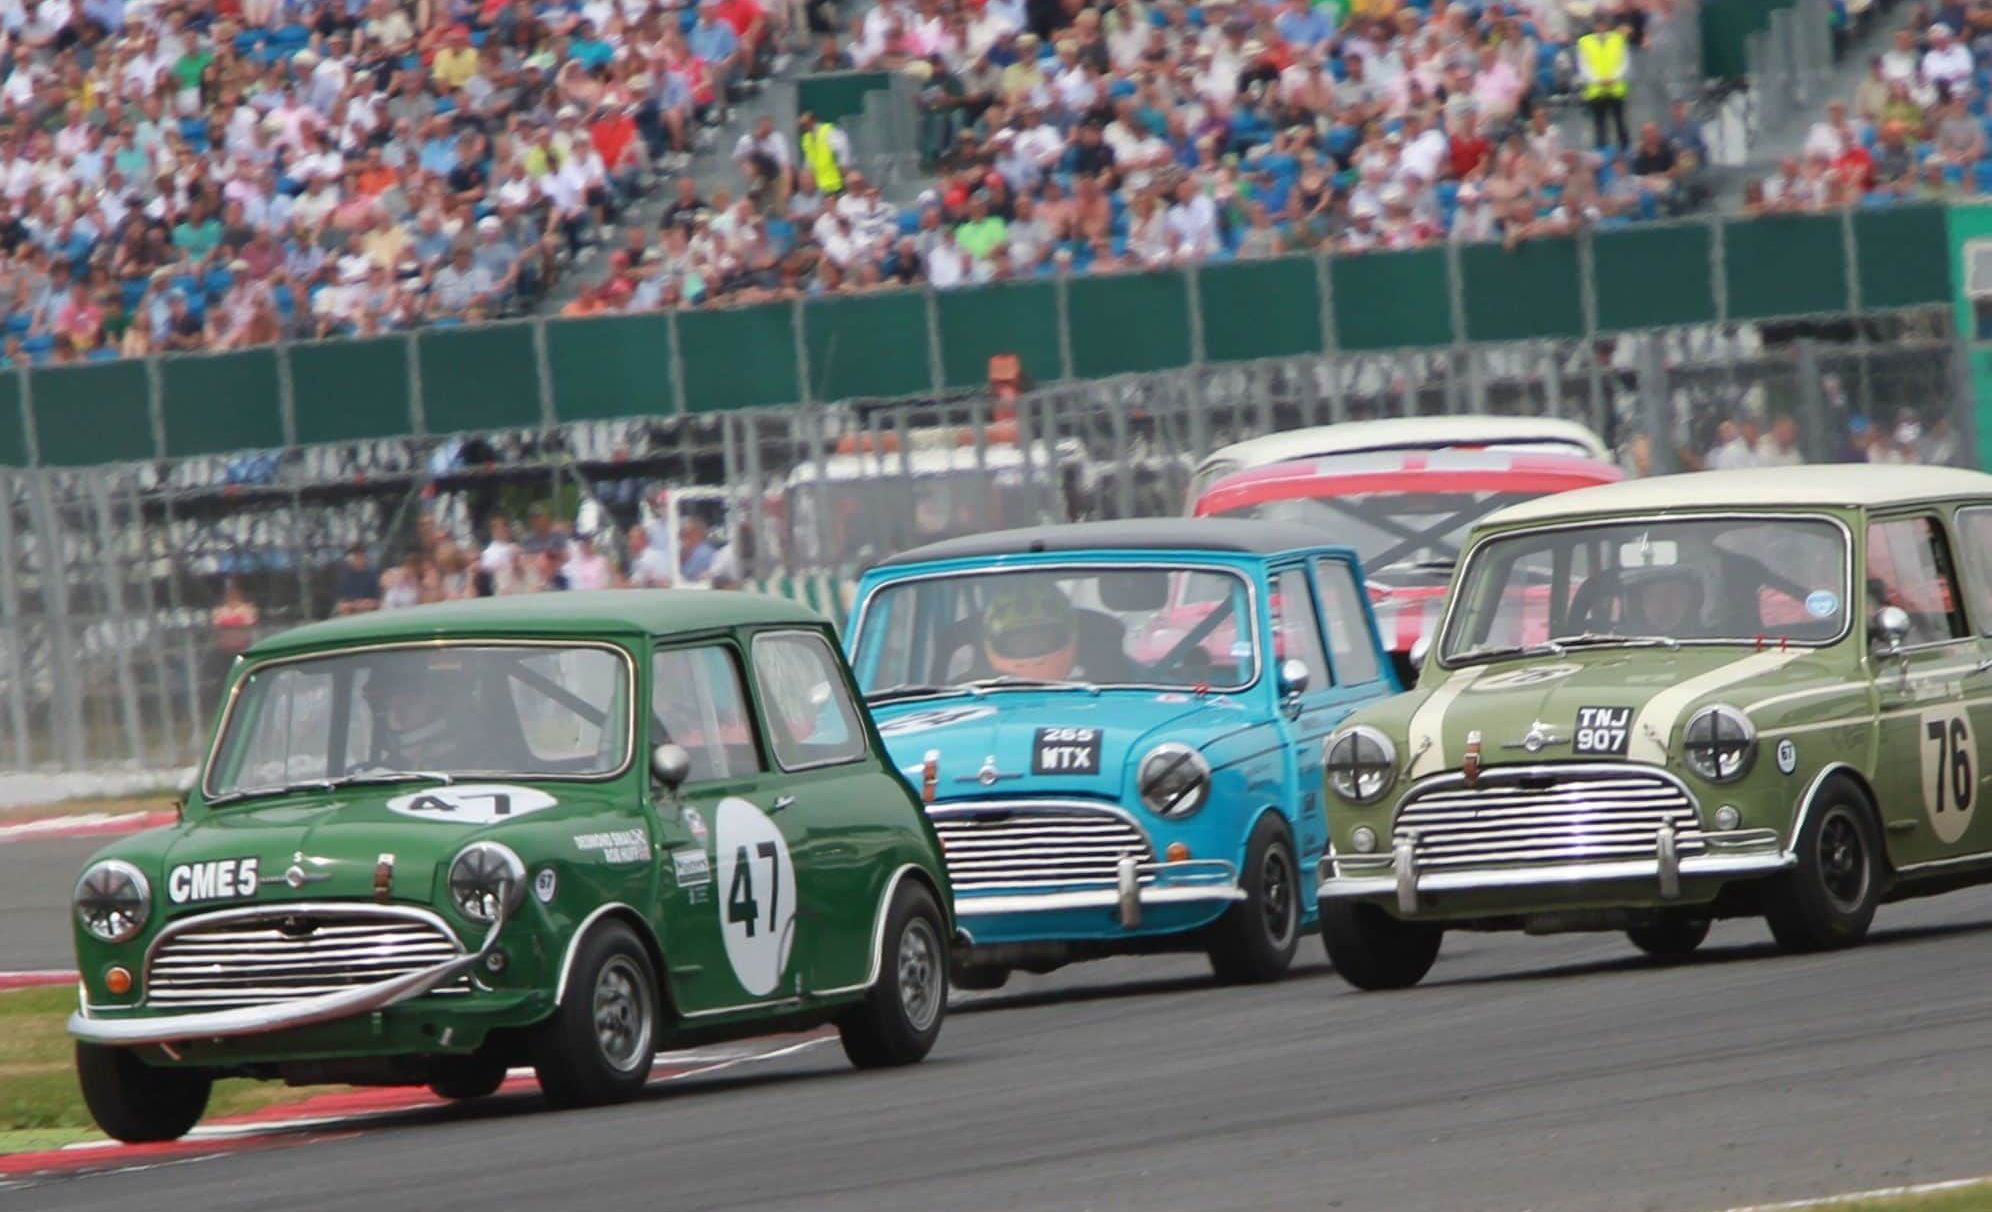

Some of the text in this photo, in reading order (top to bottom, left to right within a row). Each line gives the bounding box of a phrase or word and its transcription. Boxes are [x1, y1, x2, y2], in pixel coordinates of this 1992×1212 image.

[1579, 708, 1629, 727] TNJ
[1577, 729, 1626, 751] 907
[1926, 716, 1973, 814] 76
[409, 793, 512, 815] 47
[728, 841, 780, 938] 47
